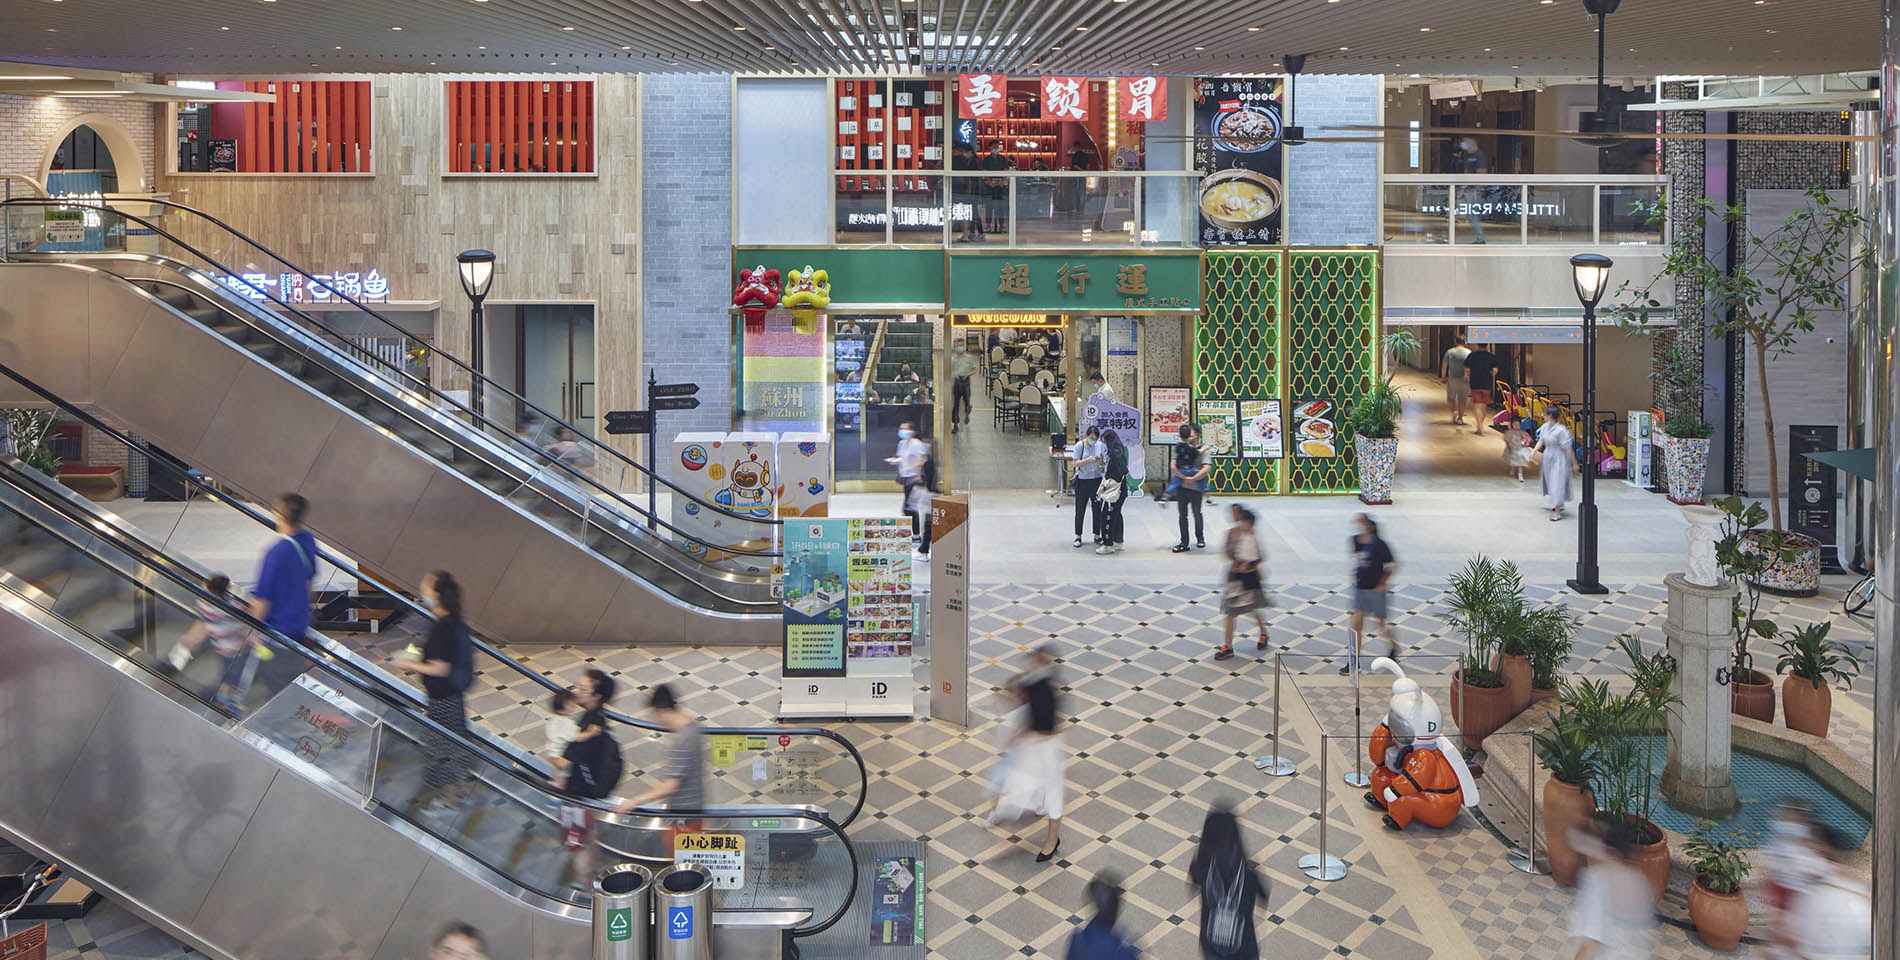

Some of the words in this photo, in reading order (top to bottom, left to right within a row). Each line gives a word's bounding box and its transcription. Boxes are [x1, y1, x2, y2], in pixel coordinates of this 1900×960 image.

[964, 75, 1001, 117] 吾
[306, 268, 390, 299] 石锅鱼
[997, 263, 1149, 295] 超行運
[808, 684, 819, 693] iD
[872, 682, 888, 695] iD
[1427, 721, 1437, 733] D
[682, 835, 739, 849] 小心脚趾
